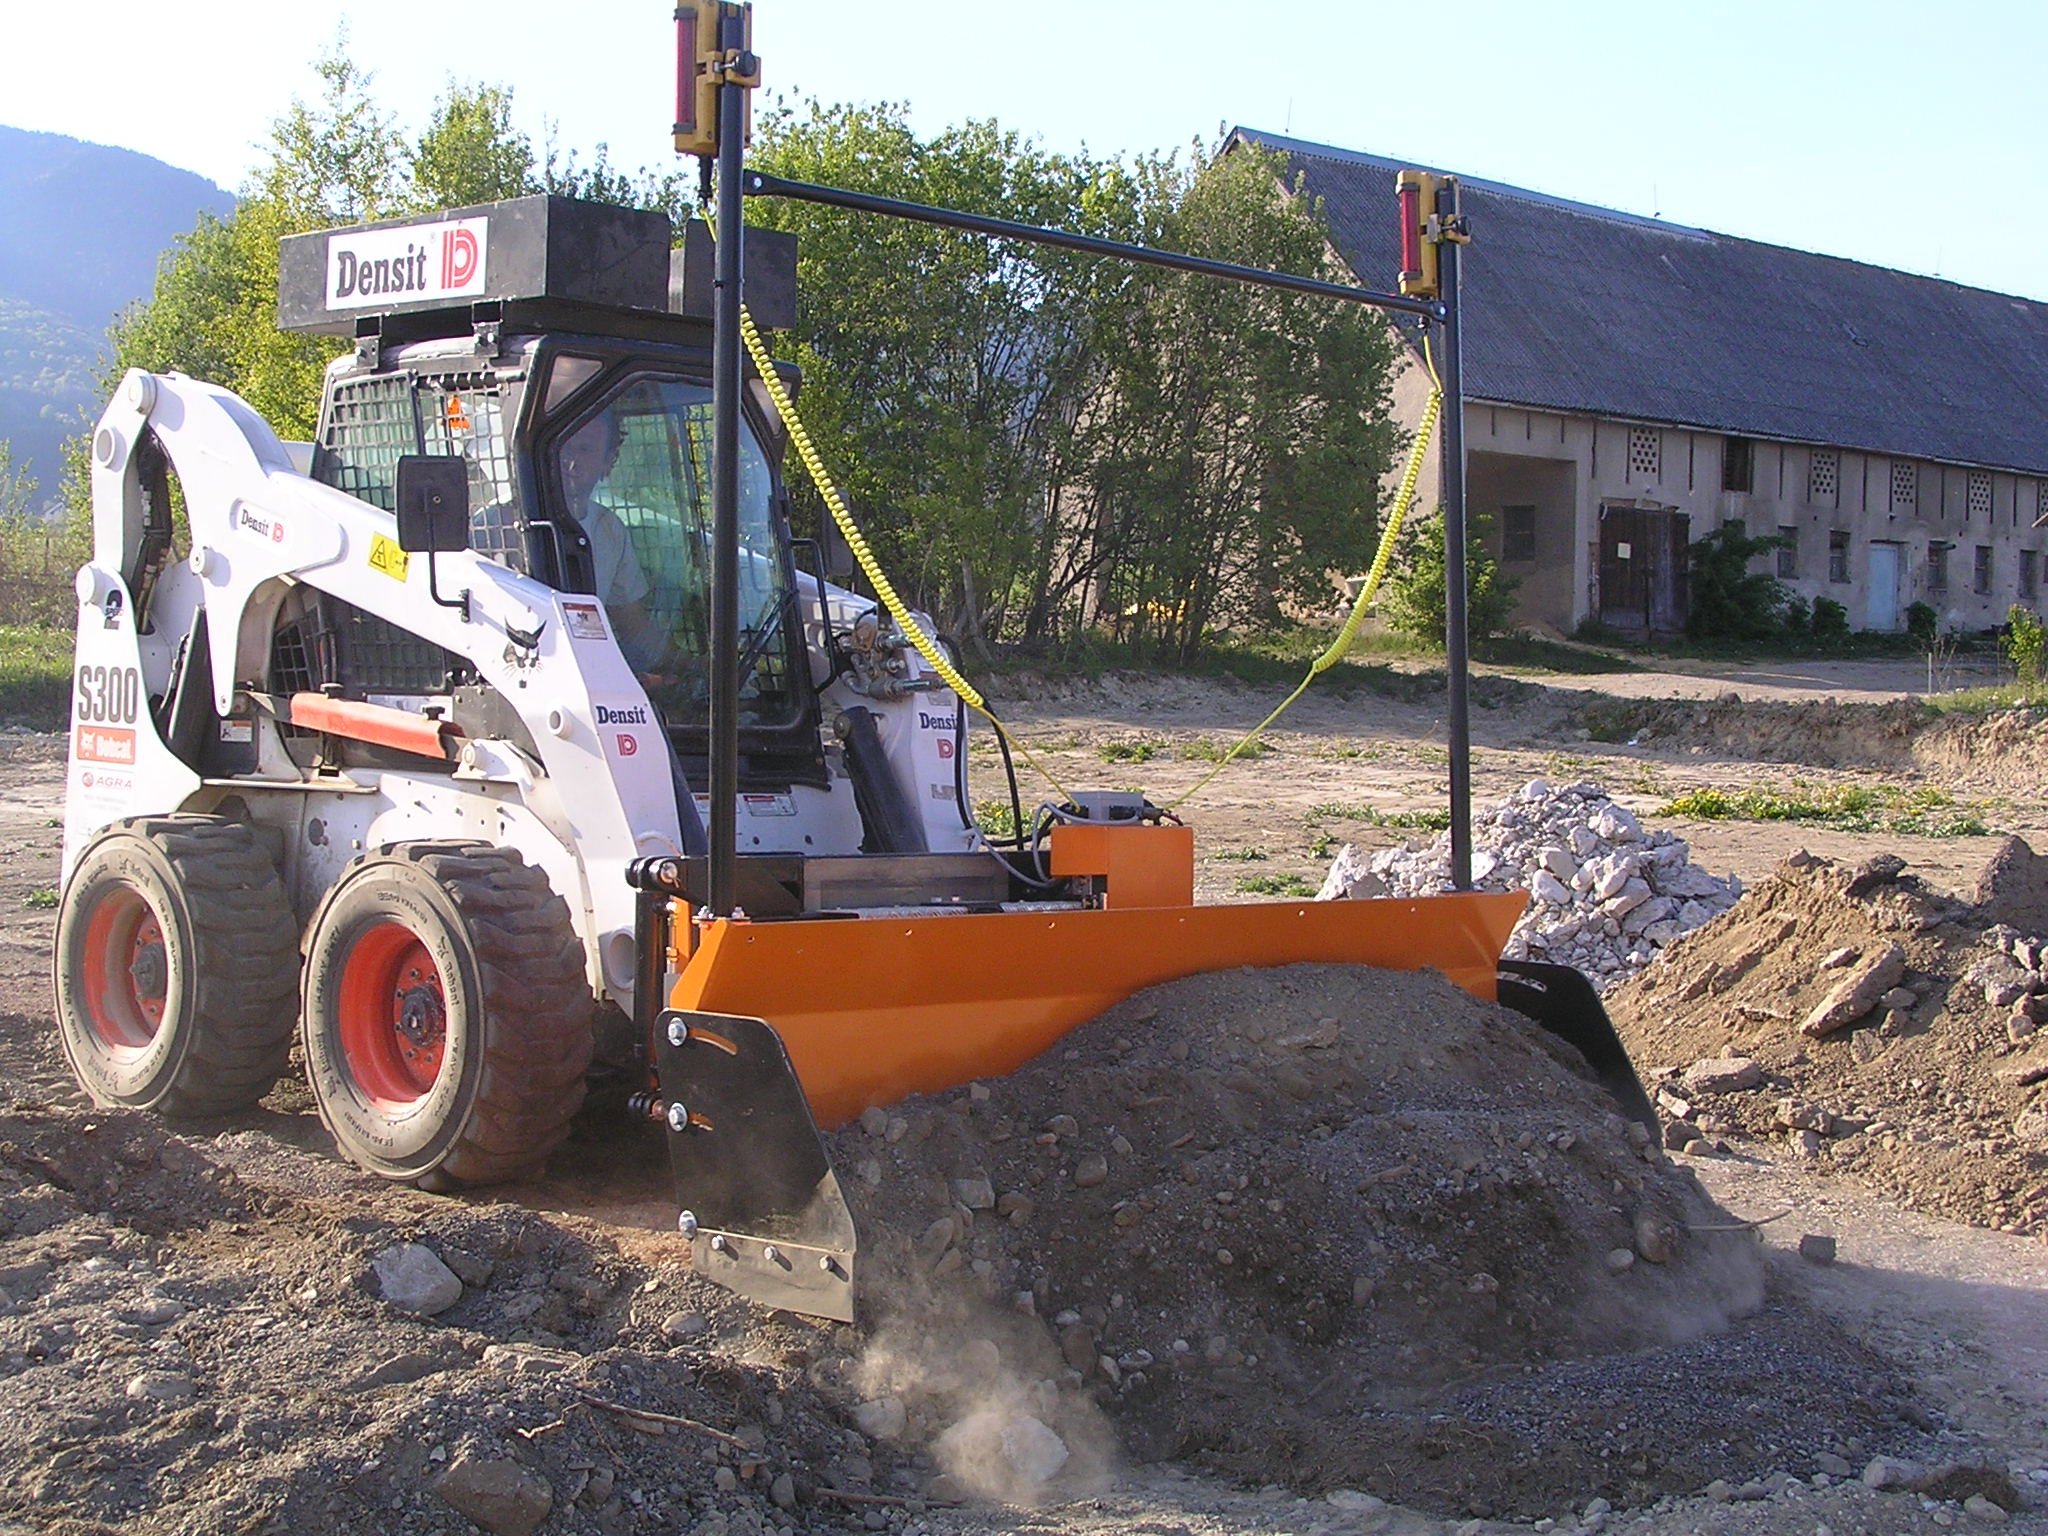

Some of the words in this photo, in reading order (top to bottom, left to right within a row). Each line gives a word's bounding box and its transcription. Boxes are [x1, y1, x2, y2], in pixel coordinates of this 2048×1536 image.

[336, 243, 427, 298] Densit
[241, 509, 269, 536] Densit
[78, 665, 138, 724] S300
[596, 706, 647, 724] Densit
[919, 712, 958, 730] Densi
[96, 776, 132, 790] AGRA
